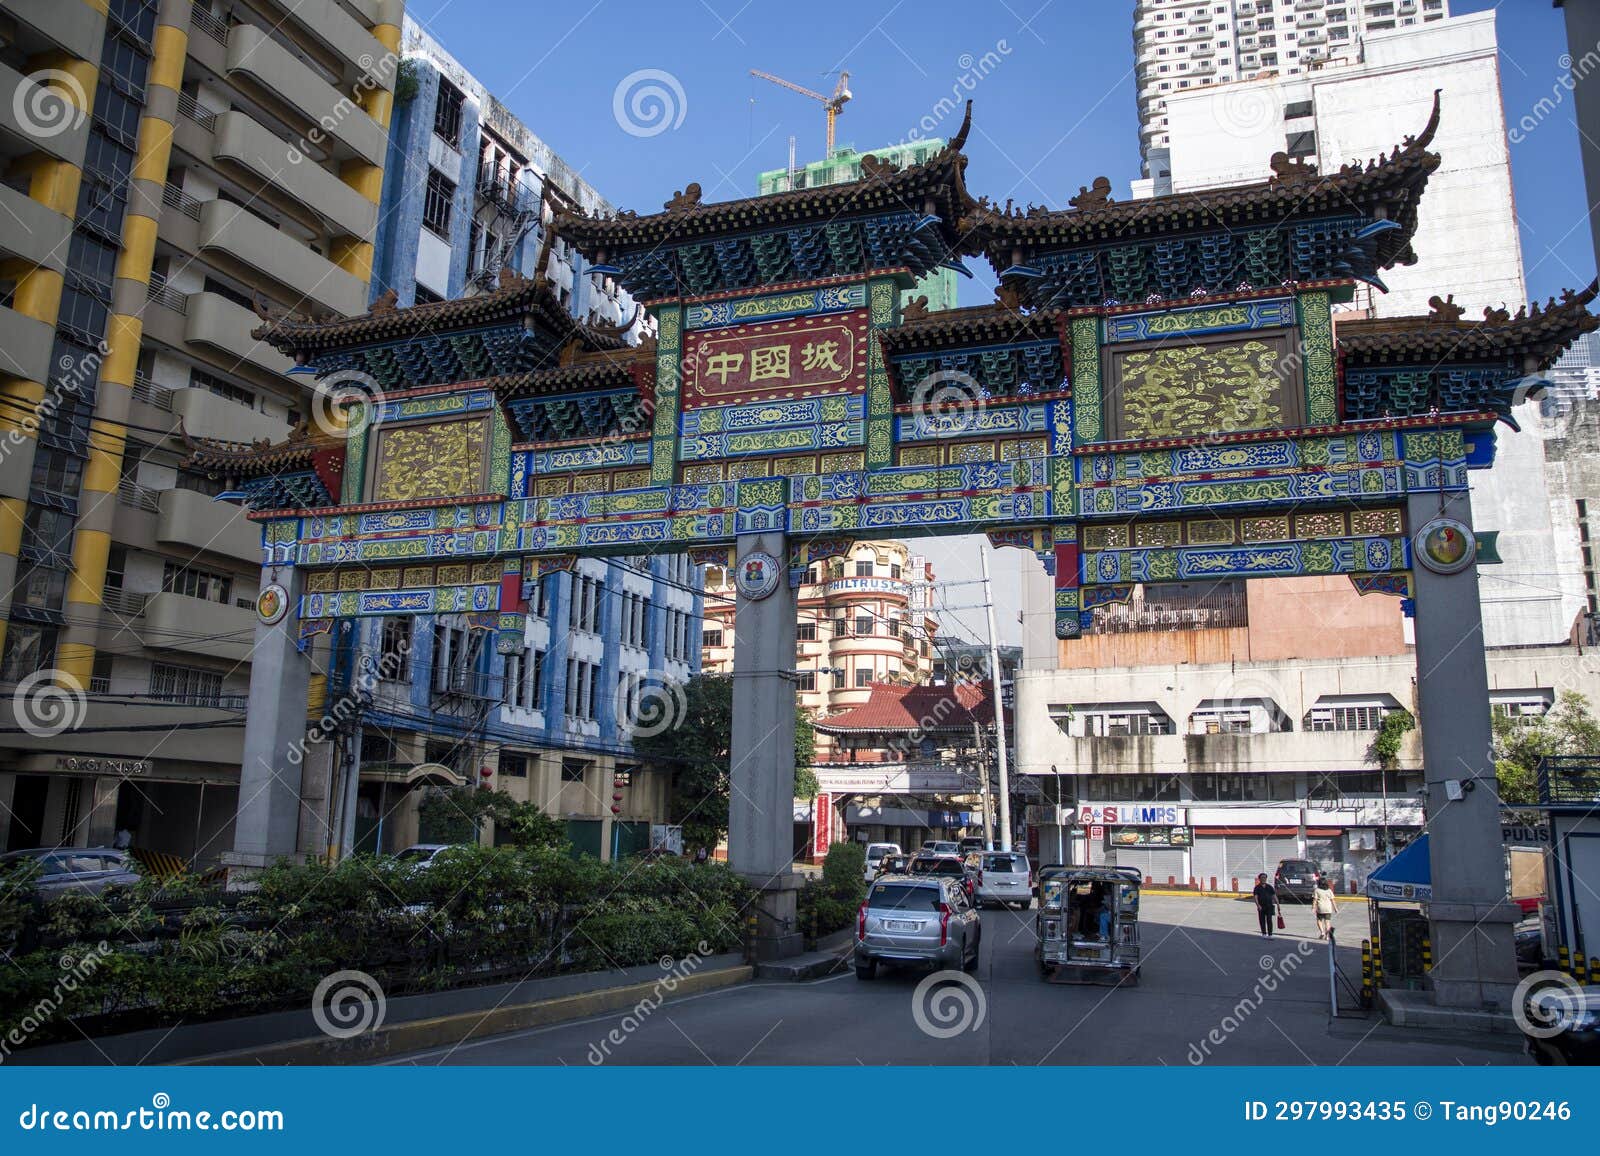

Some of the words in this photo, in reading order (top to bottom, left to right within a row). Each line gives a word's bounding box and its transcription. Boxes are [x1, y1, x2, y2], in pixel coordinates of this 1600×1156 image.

[704, 340, 843, 385] 中國城
[828, 579, 896, 592] PHILTRUST
[1121, 807, 1177, 823] LAMPS
[1503, 827, 1549, 843] PULIS
